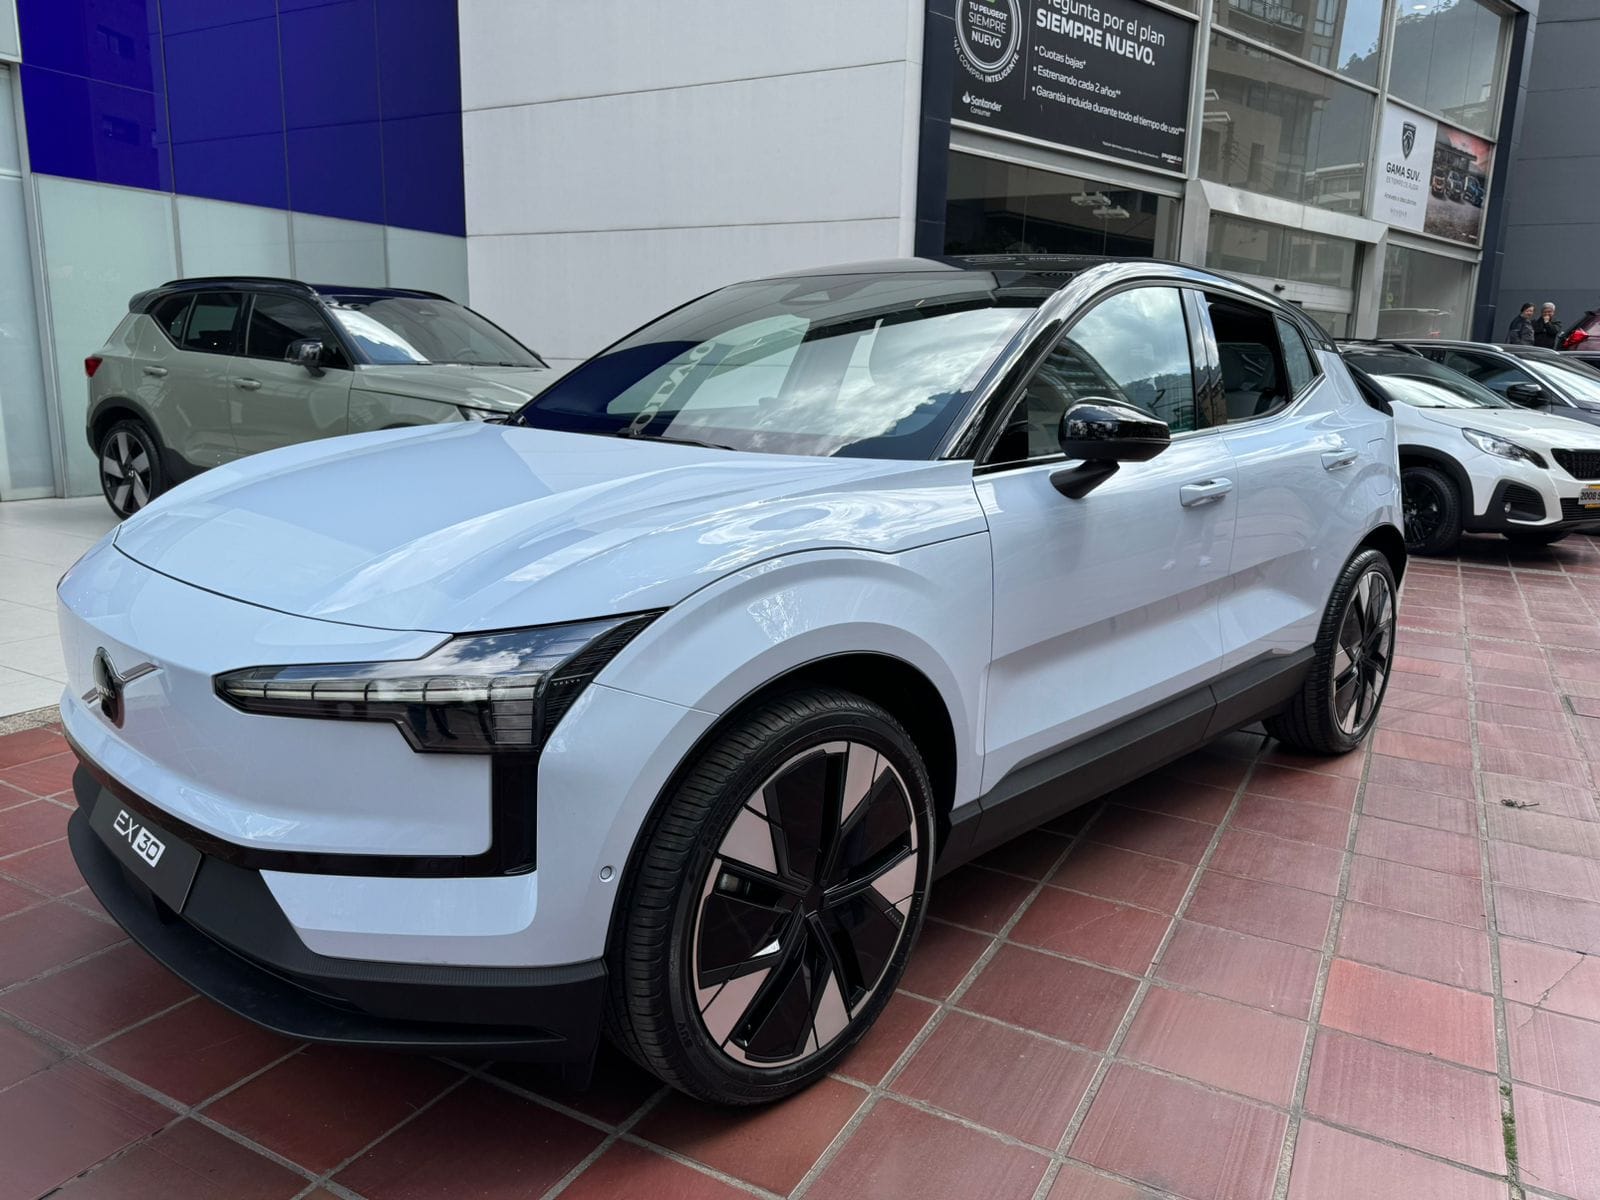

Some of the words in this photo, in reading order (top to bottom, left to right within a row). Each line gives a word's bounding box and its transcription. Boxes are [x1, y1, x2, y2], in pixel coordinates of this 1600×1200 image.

[968, 13, 1007, 34] SIEMPRE
[969, 2, 979, 12] TU
[979, 5, 1008, 21] PEUGEOT
[1039, 0, 1100, 23] egunta
[1104, 11, 1125, 32] por
[1126, 20, 1137, 35] el
[1140, 25, 1166, 47] plan
[971, 30, 1002, 49] NUEVO
[1036, 8, 1103, 48] SIEMPRE
[1105, 32, 1156, 67] NUEVO.
[1038, 45, 1065, 63] Cuotas
[959, 54, 984, 82] COMPRA
[984, 52, 1020, 83] INTELIGENTE
[1037, 65, 1078, 87] Estrenando
[1077, 78, 1095, 92] cada
[1094, 82, 1100, 93] 2
[970, 94, 1003, 112] Santander
[1036, 85, 1066, 103] Garantía
[1092, 101, 1118, 119] durante
[1118, 110, 1133, 122] todo
[1133, 114, 1140, 124] el
[1139, 115, 1160, 130] tiempo
[1159, 121, 1169, 132] de
[1386, 162, 1406, 178] GAMA
[113, 809, 166, 868] EX30
